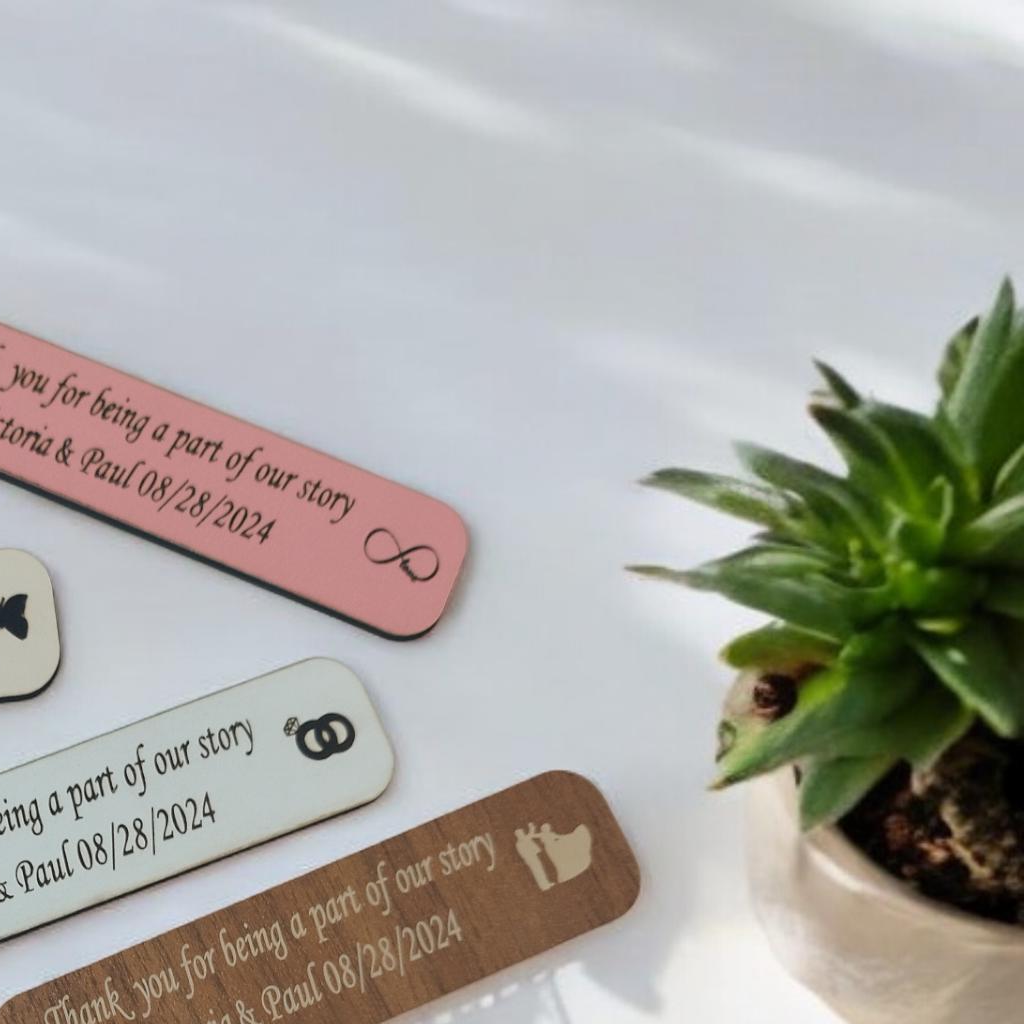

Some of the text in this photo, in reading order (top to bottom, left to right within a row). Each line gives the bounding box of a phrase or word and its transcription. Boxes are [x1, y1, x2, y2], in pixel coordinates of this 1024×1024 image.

[2, 364, 50, 395] you
[40, 373, 91, 408] for
[90, 387, 151, 443] being
[152, 424, 170, 442] a
[164, 429, 223, 462] part
[225, 447, 263, 482] of
[255, 464, 299, 491] our
[296, 480, 355, 524] story
[55, 437, 74, 467] &
[80, 448, 146, 489] Paul
[138, 470, 276, 544] 08/28/2024
[48, 791, 64, 816] a
[66, 766, 118, 821] part
[124, 743, 146, 797] of
[154, 740, 189, 775] our
[198, 719, 253, 759] story
[15, 839, 74, 893] Paul
[77, 792, 215, 871] 08/28/2024
[133, 968, 179, 1018] you
[180, 944, 215, 999] for
[219, 921, 288, 967] being
[290, 912, 307, 939] a
[309, 885, 362, 943] part
[366, 861, 390, 916] of
[396, 856, 433, 893] our
[439, 833, 496, 875] story
[261, 961, 322, 1021] Paul
[323, 909, 462, 994] 08/28/2024
